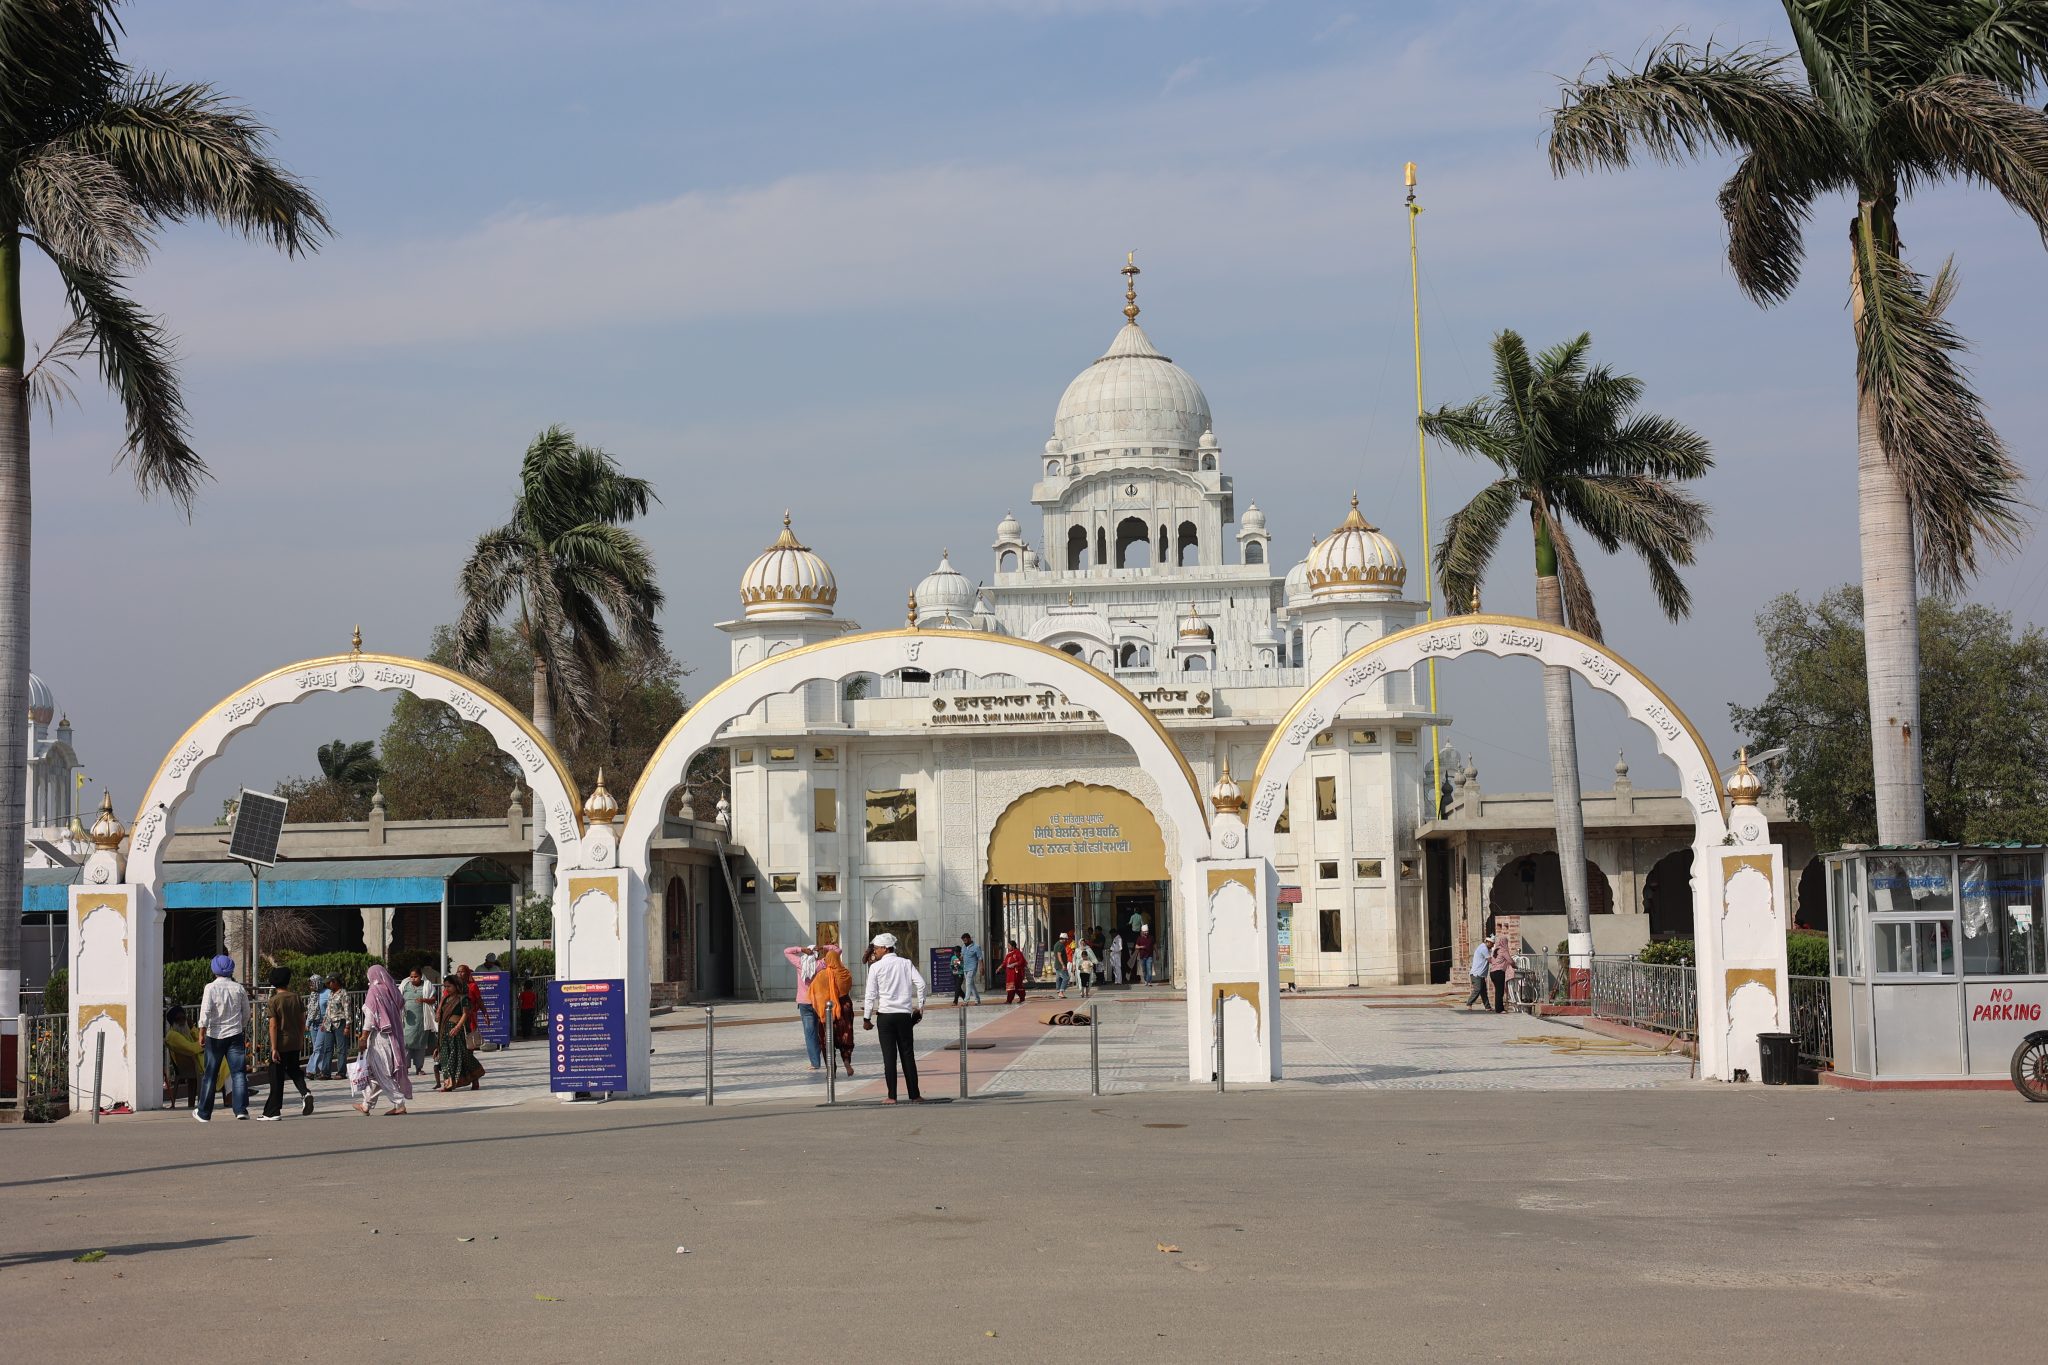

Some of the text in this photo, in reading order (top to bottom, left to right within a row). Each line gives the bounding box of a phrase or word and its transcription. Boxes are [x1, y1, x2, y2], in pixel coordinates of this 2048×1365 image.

[953, 694, 1031, 711] ਗੁਰਦੁਆਰਾ
[1036, 690, 1056, 710] ਸ੍ਰੀ
[1139, 686, 1188, 703] ਸਾਹਿਬ
[932, 714, 980, 724] GURUDWARA
[983, 713, 1002, 723] SHRI
[1004, 711, 1056, 721] NANAKMATTA
[1060, 710, 1084, 720] SAHIB
[1990, 988, 2013, 1002] NO
[1973, 1004, 2041, 1021] PARKING
